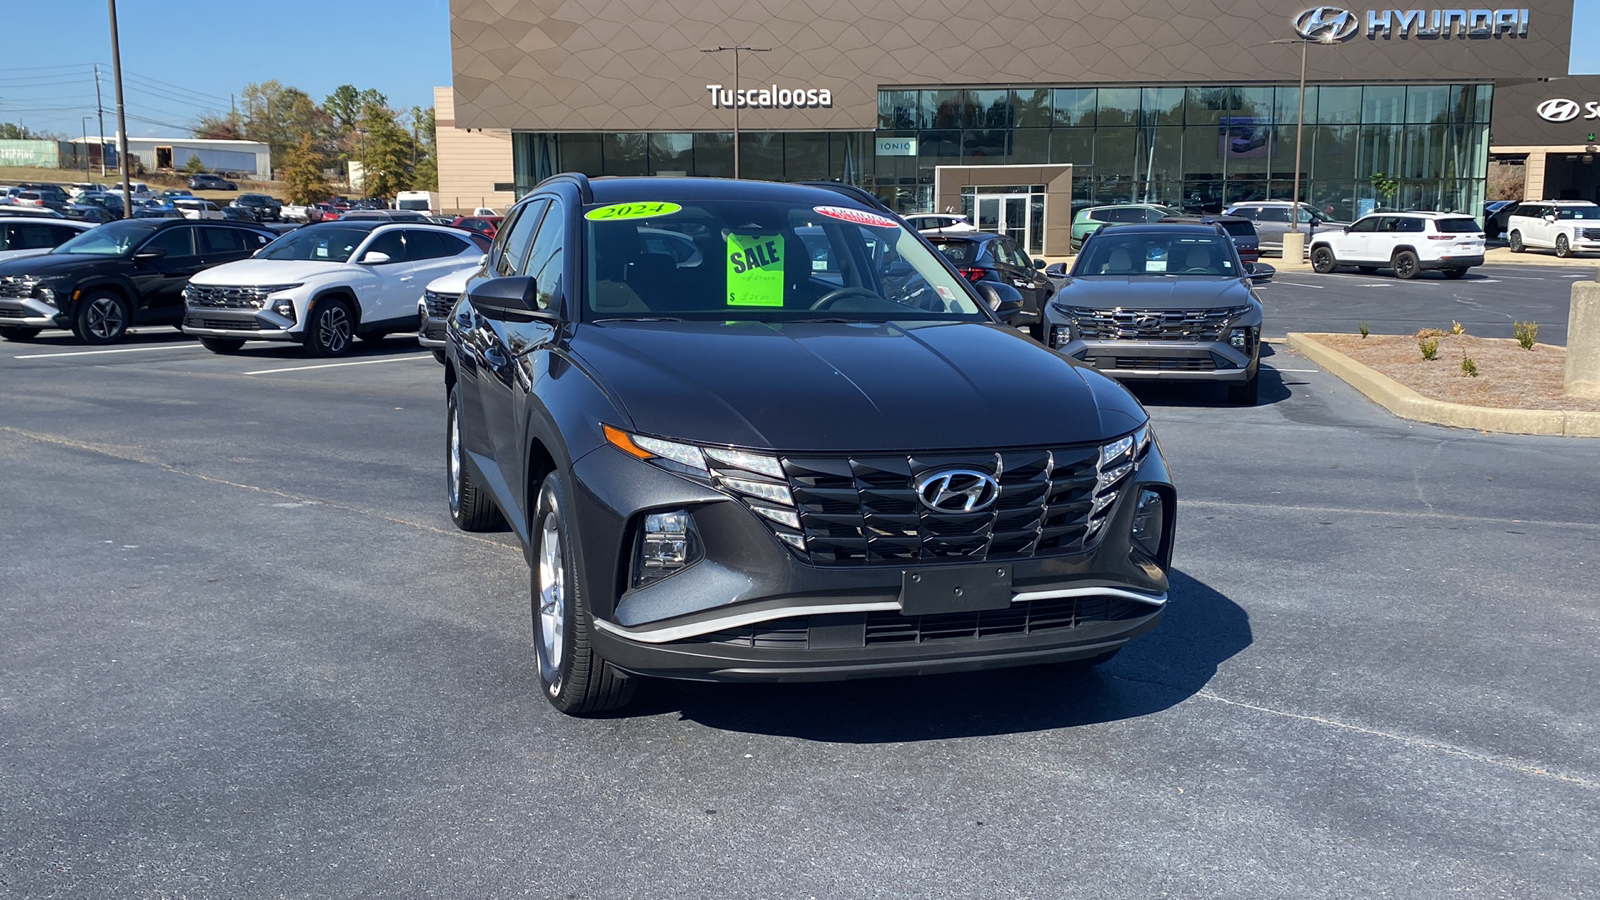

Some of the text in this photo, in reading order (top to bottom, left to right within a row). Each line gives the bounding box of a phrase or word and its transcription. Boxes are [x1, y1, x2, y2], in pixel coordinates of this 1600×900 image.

[1366, 9, 1529, 38] HYUNDAI
[706, 84, 832, 107] Tuscaloosa
[1584, 101, 1600, 119] S
[600, 203, 665, 219] 2024
[730, 240, 781, 274] SALE
